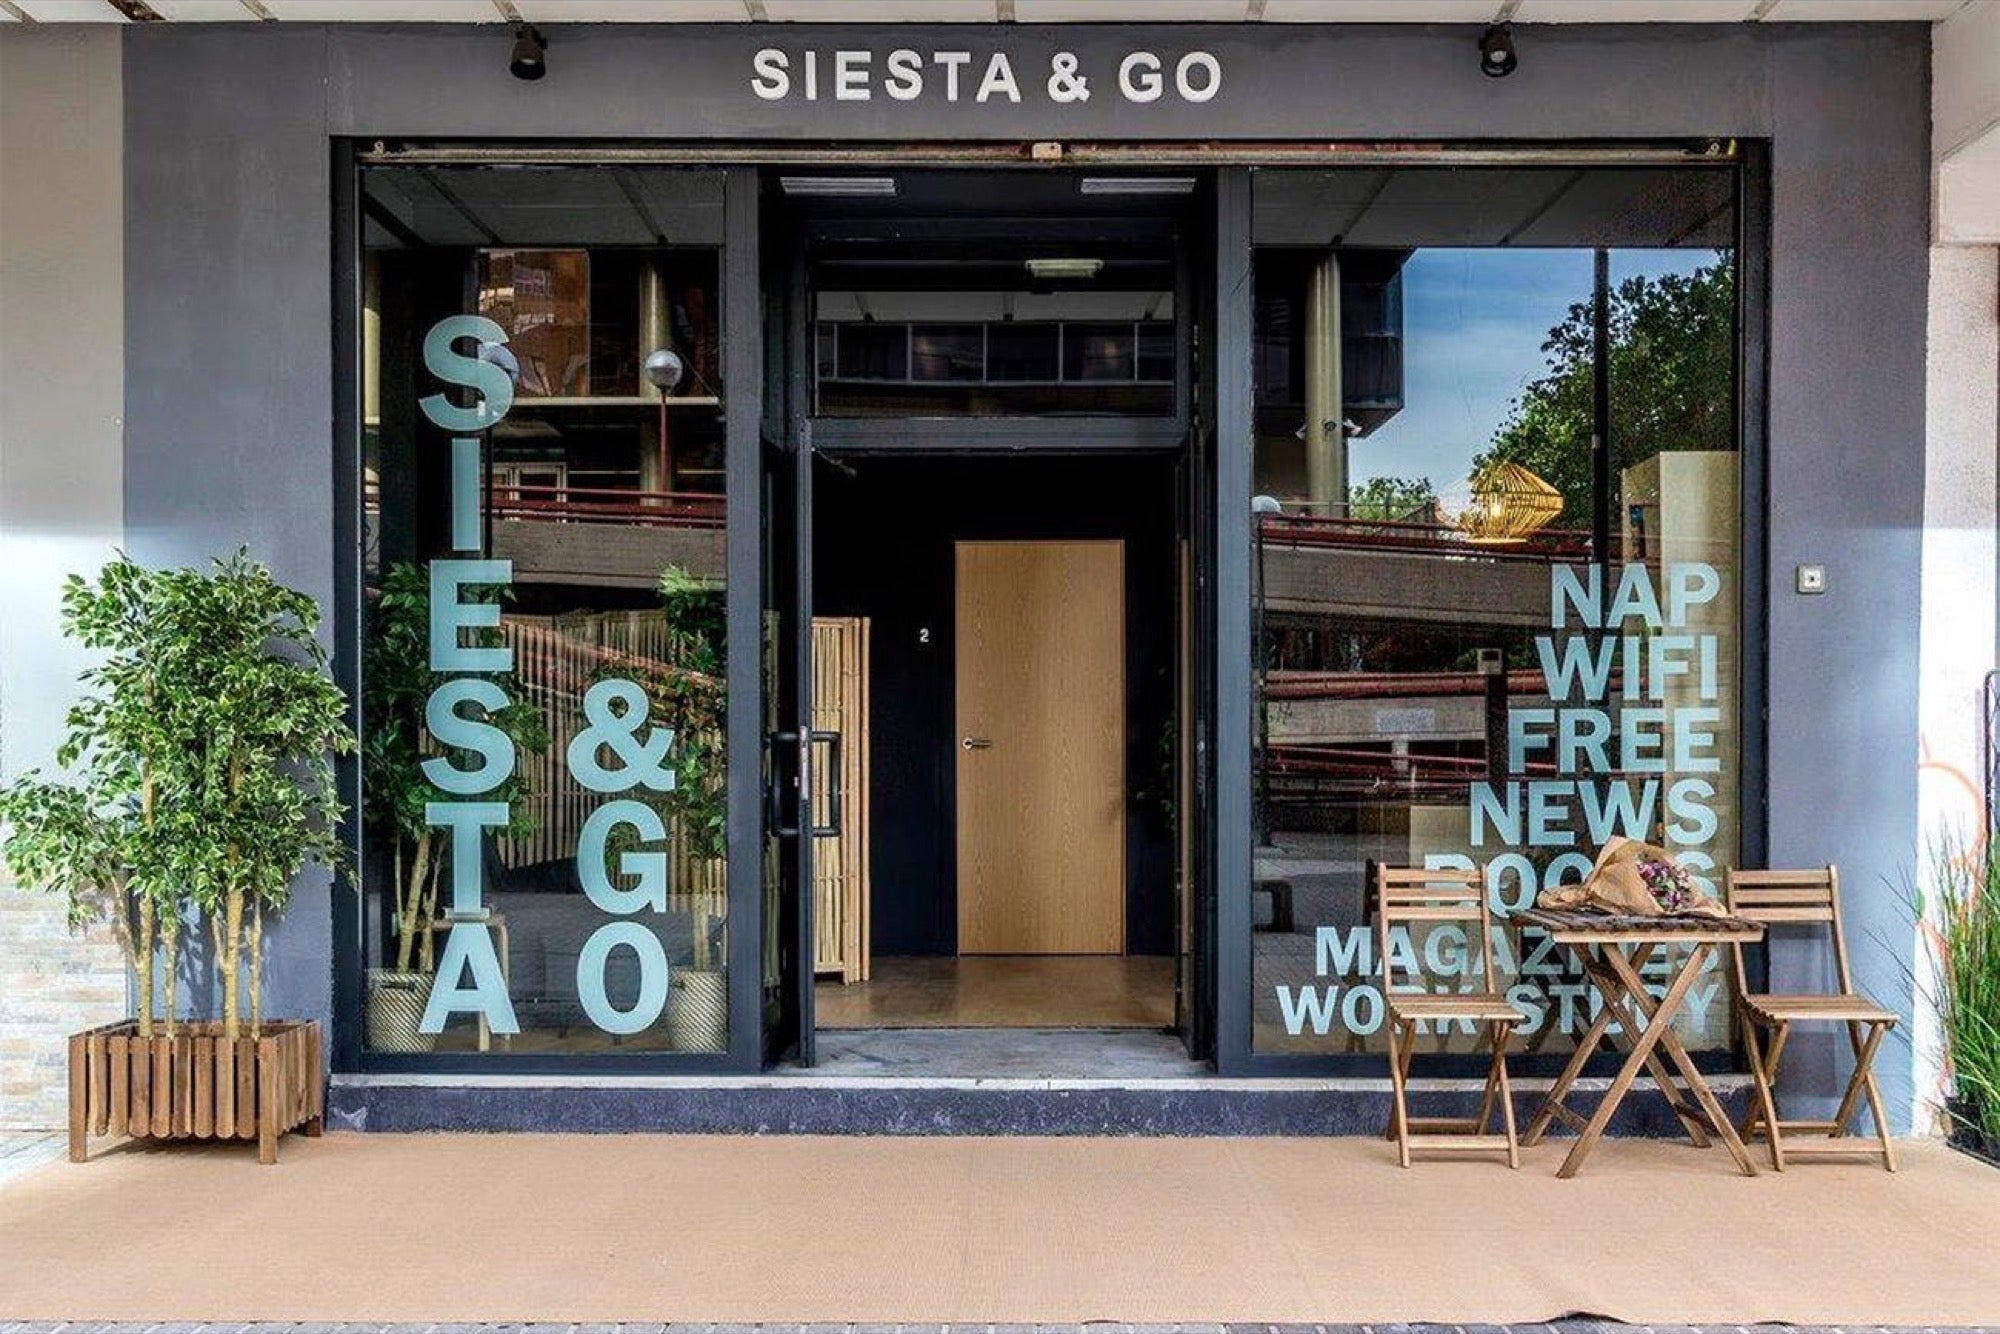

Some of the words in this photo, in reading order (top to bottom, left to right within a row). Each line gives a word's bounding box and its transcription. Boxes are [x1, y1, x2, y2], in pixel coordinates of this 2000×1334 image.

[751, 48, 1022, 102] SIESTA
[1047, 51, 1091, 102] &
[1118, 51, 1222, 103] GO
[1551, 563, 1721, 629] NAP
[919, 627, 930, 643] 2
[1535, 635, 1718, 701] WIFI
[418, 314, 520, 1035] SIESTA
[566, 679, 677, 794] &
[1508, 707, 1721, 773] FREE
[1470, 778, 1719, 847] NEWS
[576, 801, 670, 1035] GO
